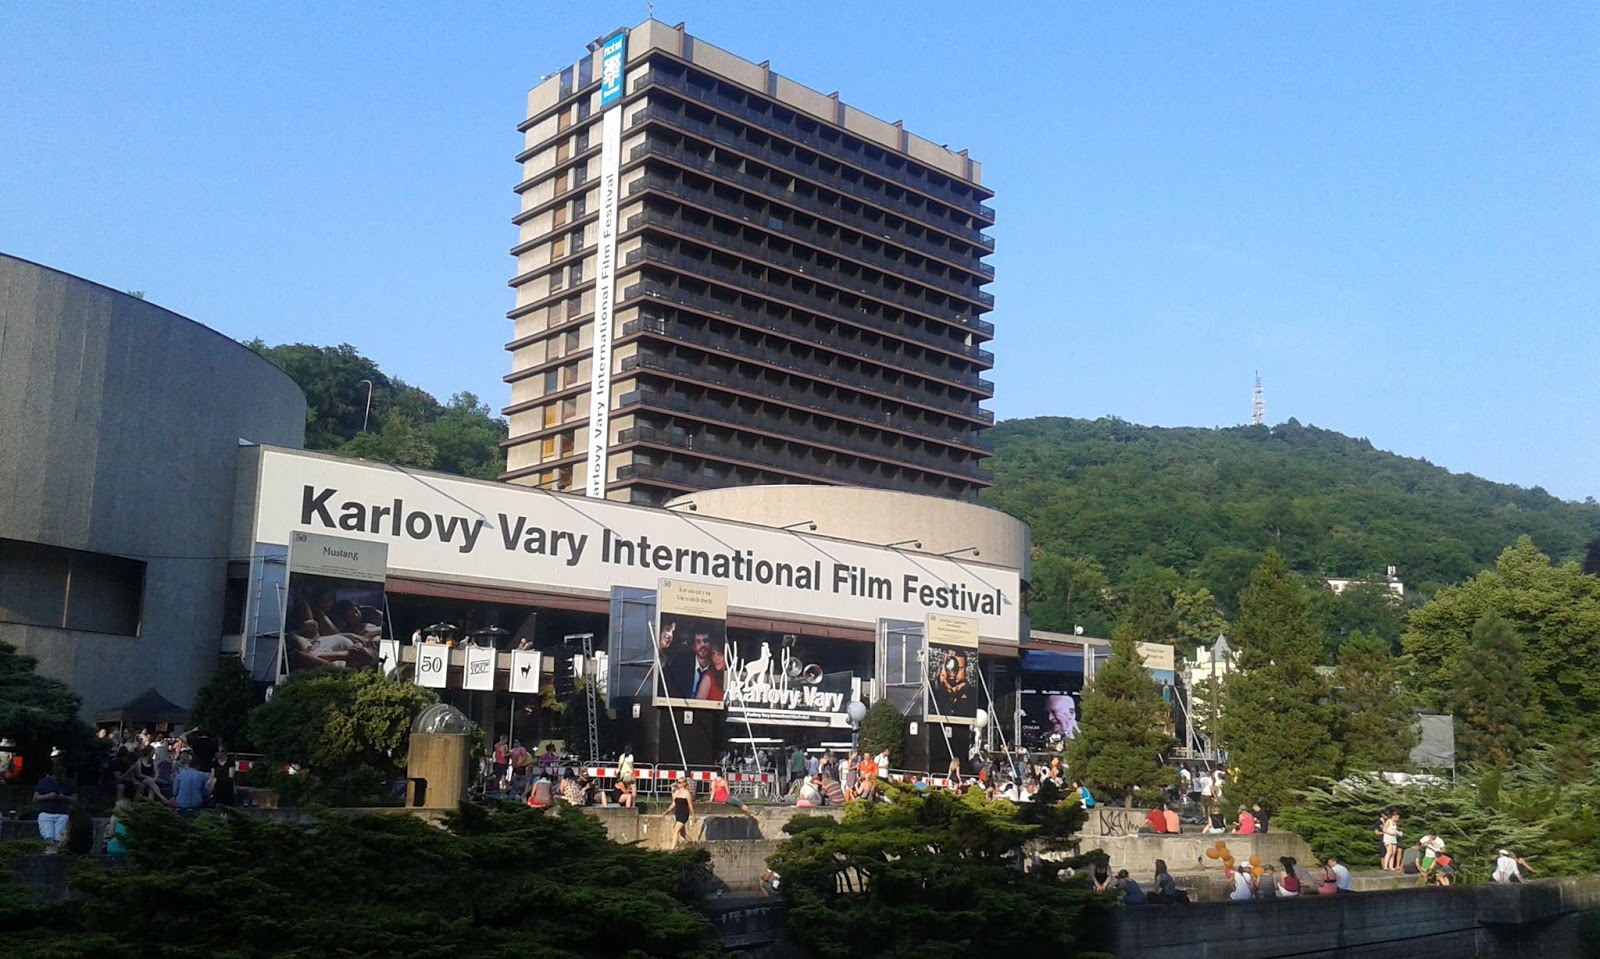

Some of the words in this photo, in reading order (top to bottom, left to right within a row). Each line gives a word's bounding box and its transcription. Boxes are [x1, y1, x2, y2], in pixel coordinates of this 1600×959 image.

[603, 173, 614, 239] Festival
[601, 243, 611, 280] Film
[597, 284, 609, 396] International
[594, 401, 605, 439] Vary
[592, 445, 603, 497] arlovy
[301, 484, 486, 554] Karlovy
[498, 513, 588, 566] Vary
[602, 528, 821, 591] International
[833, 563, 892, 601] Film
[903, 574, 1002, 616] Festival
[323, 546, 359, 560] Mustang
[421, 656, 443, 673] 50
[730, 680, 801, 710] Karlovy
[803, 685, 844, 712] Vary
